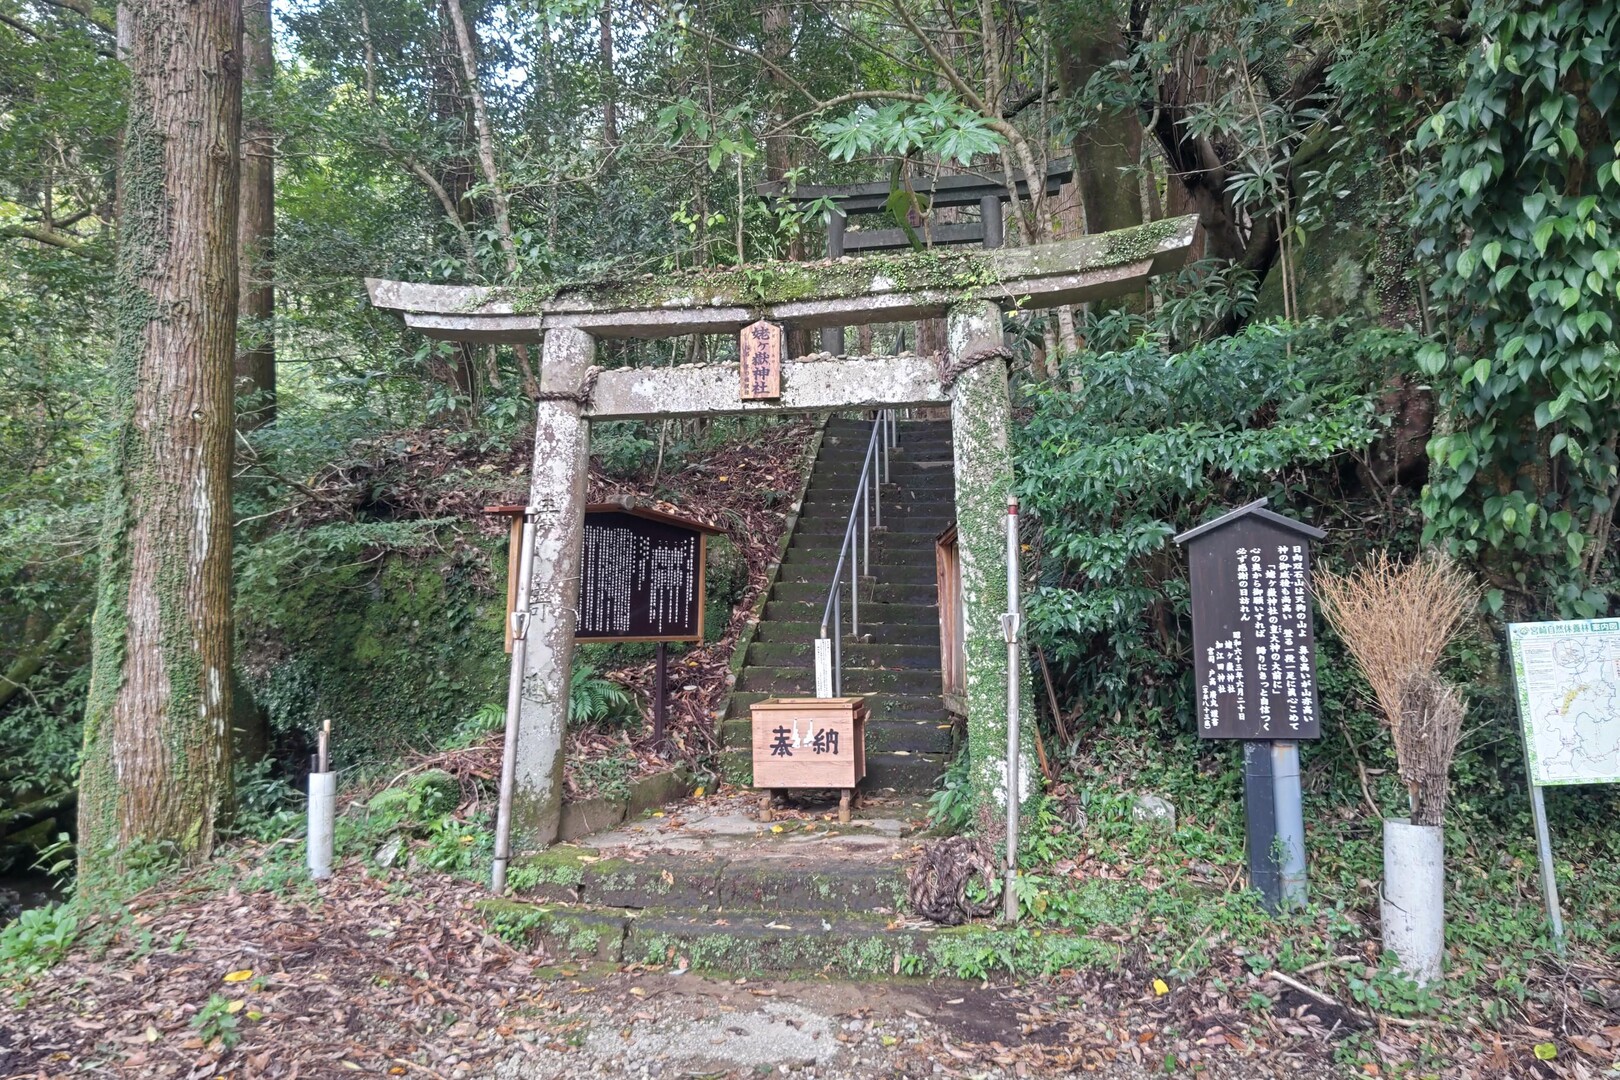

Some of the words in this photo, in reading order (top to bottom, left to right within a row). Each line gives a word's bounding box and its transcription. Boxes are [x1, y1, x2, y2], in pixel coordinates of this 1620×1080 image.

[1236, 547, 1250, 621] 必ず感謝の日訪れん
[1530, 623, 1589, 635] 宮崎自然休養林
[1215, 640, 1226, 693] 加江田神社
[1232, 631, 1245, 720] 昭和六十三年六月二十日
[770, 725, 839, 757] 奉納
